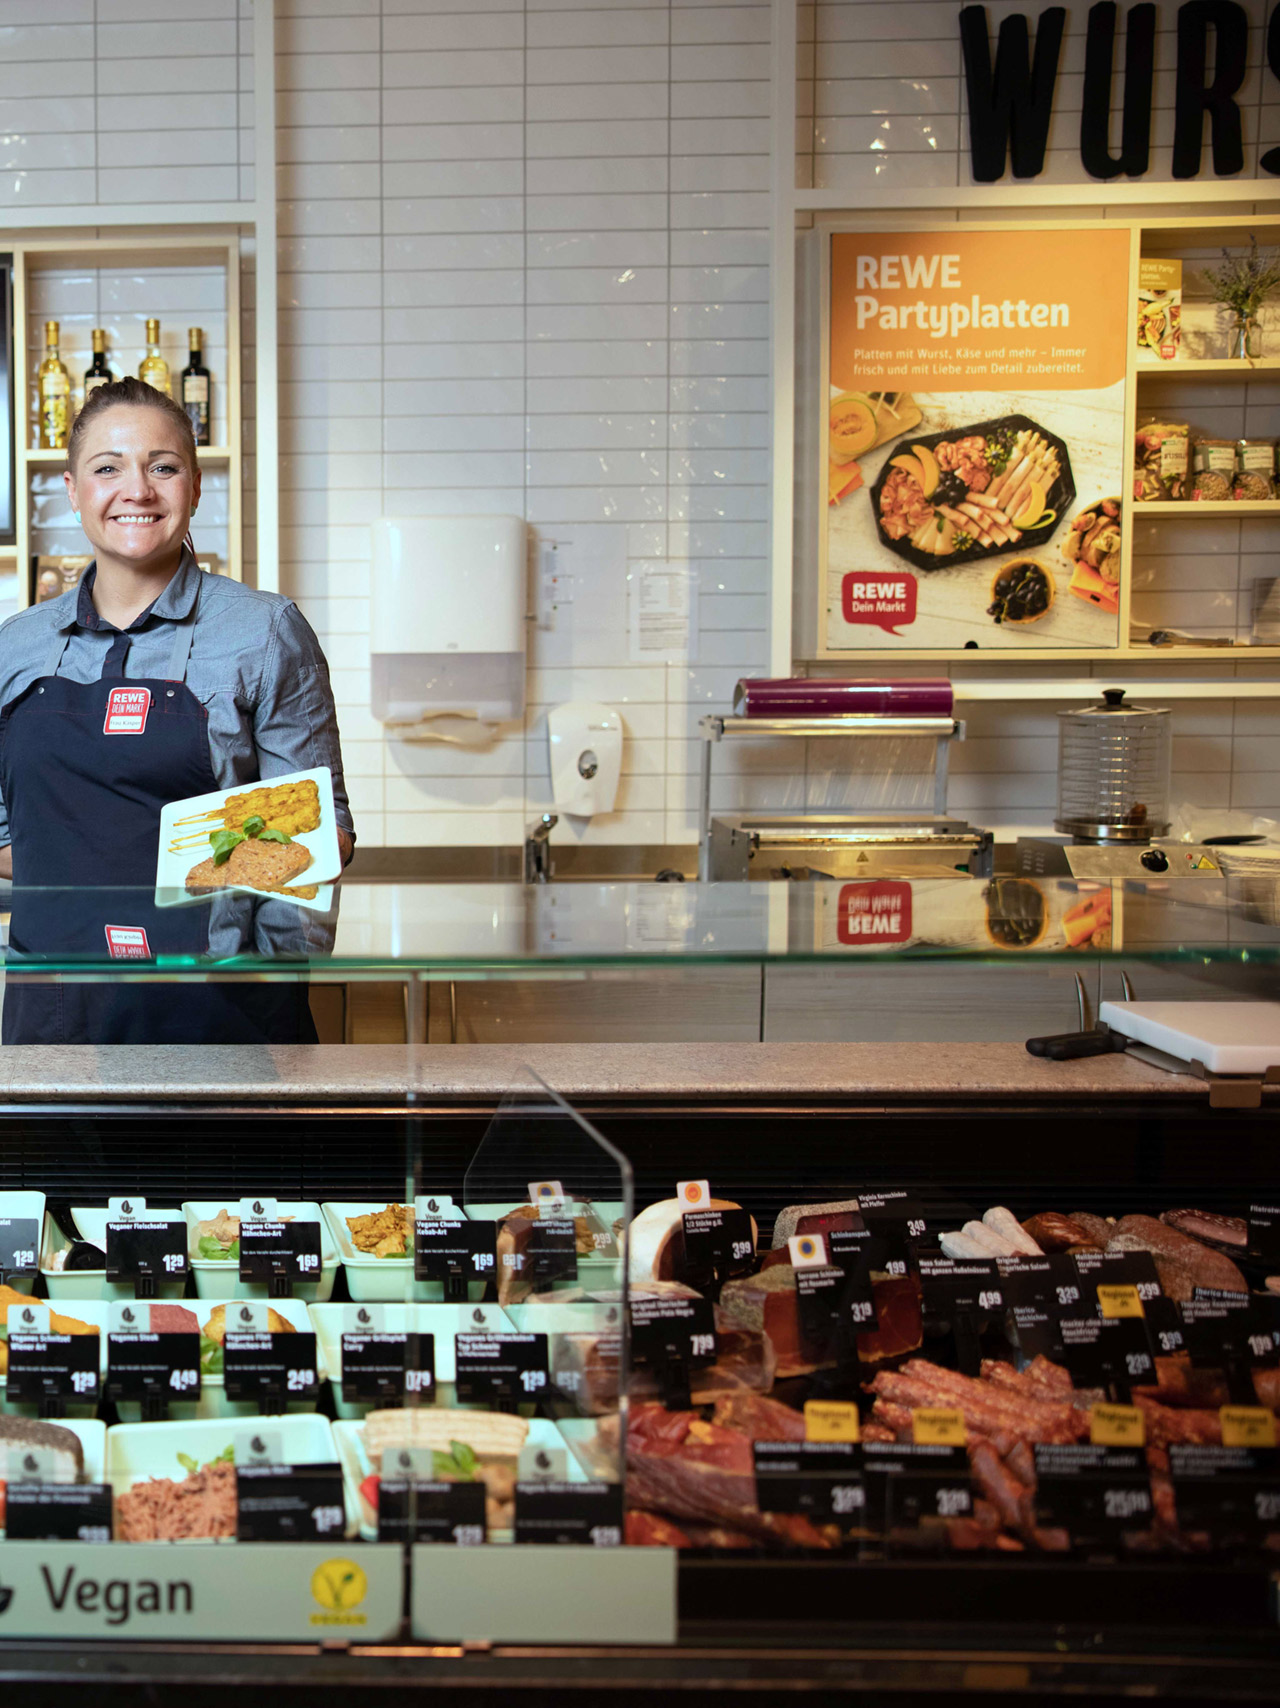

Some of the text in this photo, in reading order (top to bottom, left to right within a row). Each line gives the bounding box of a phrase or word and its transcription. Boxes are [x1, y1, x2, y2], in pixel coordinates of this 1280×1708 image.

[856, 254, 961, 289] REWE
[854, 294, 1070, 338] Partyplatten
[854, 346, 1087, 361] Platten mit Wurst, Käse und mehr Immer
[853, 362, 1085, 375] frisch und mit Liebe zum Detail zubereitet.
[852, 582, 907, 599] REWE
[852, 601, 906, 612] Dein Markt
[113, 693, 145, 703] REWE
[111, 703, 144, 713] DEIN MARKT
[108, 1222, 168, 1231] Veganer Fleischsalat
[416, 1221, 439, 1229] Vegane
[241, 1230, 282, 1238] Hähnchen-Art
[416, 1228, 448, 1236] Kebab-Art
[139, 1333, 159, 1342] Steak
[40, 1565, 194, 1625] Vegan
